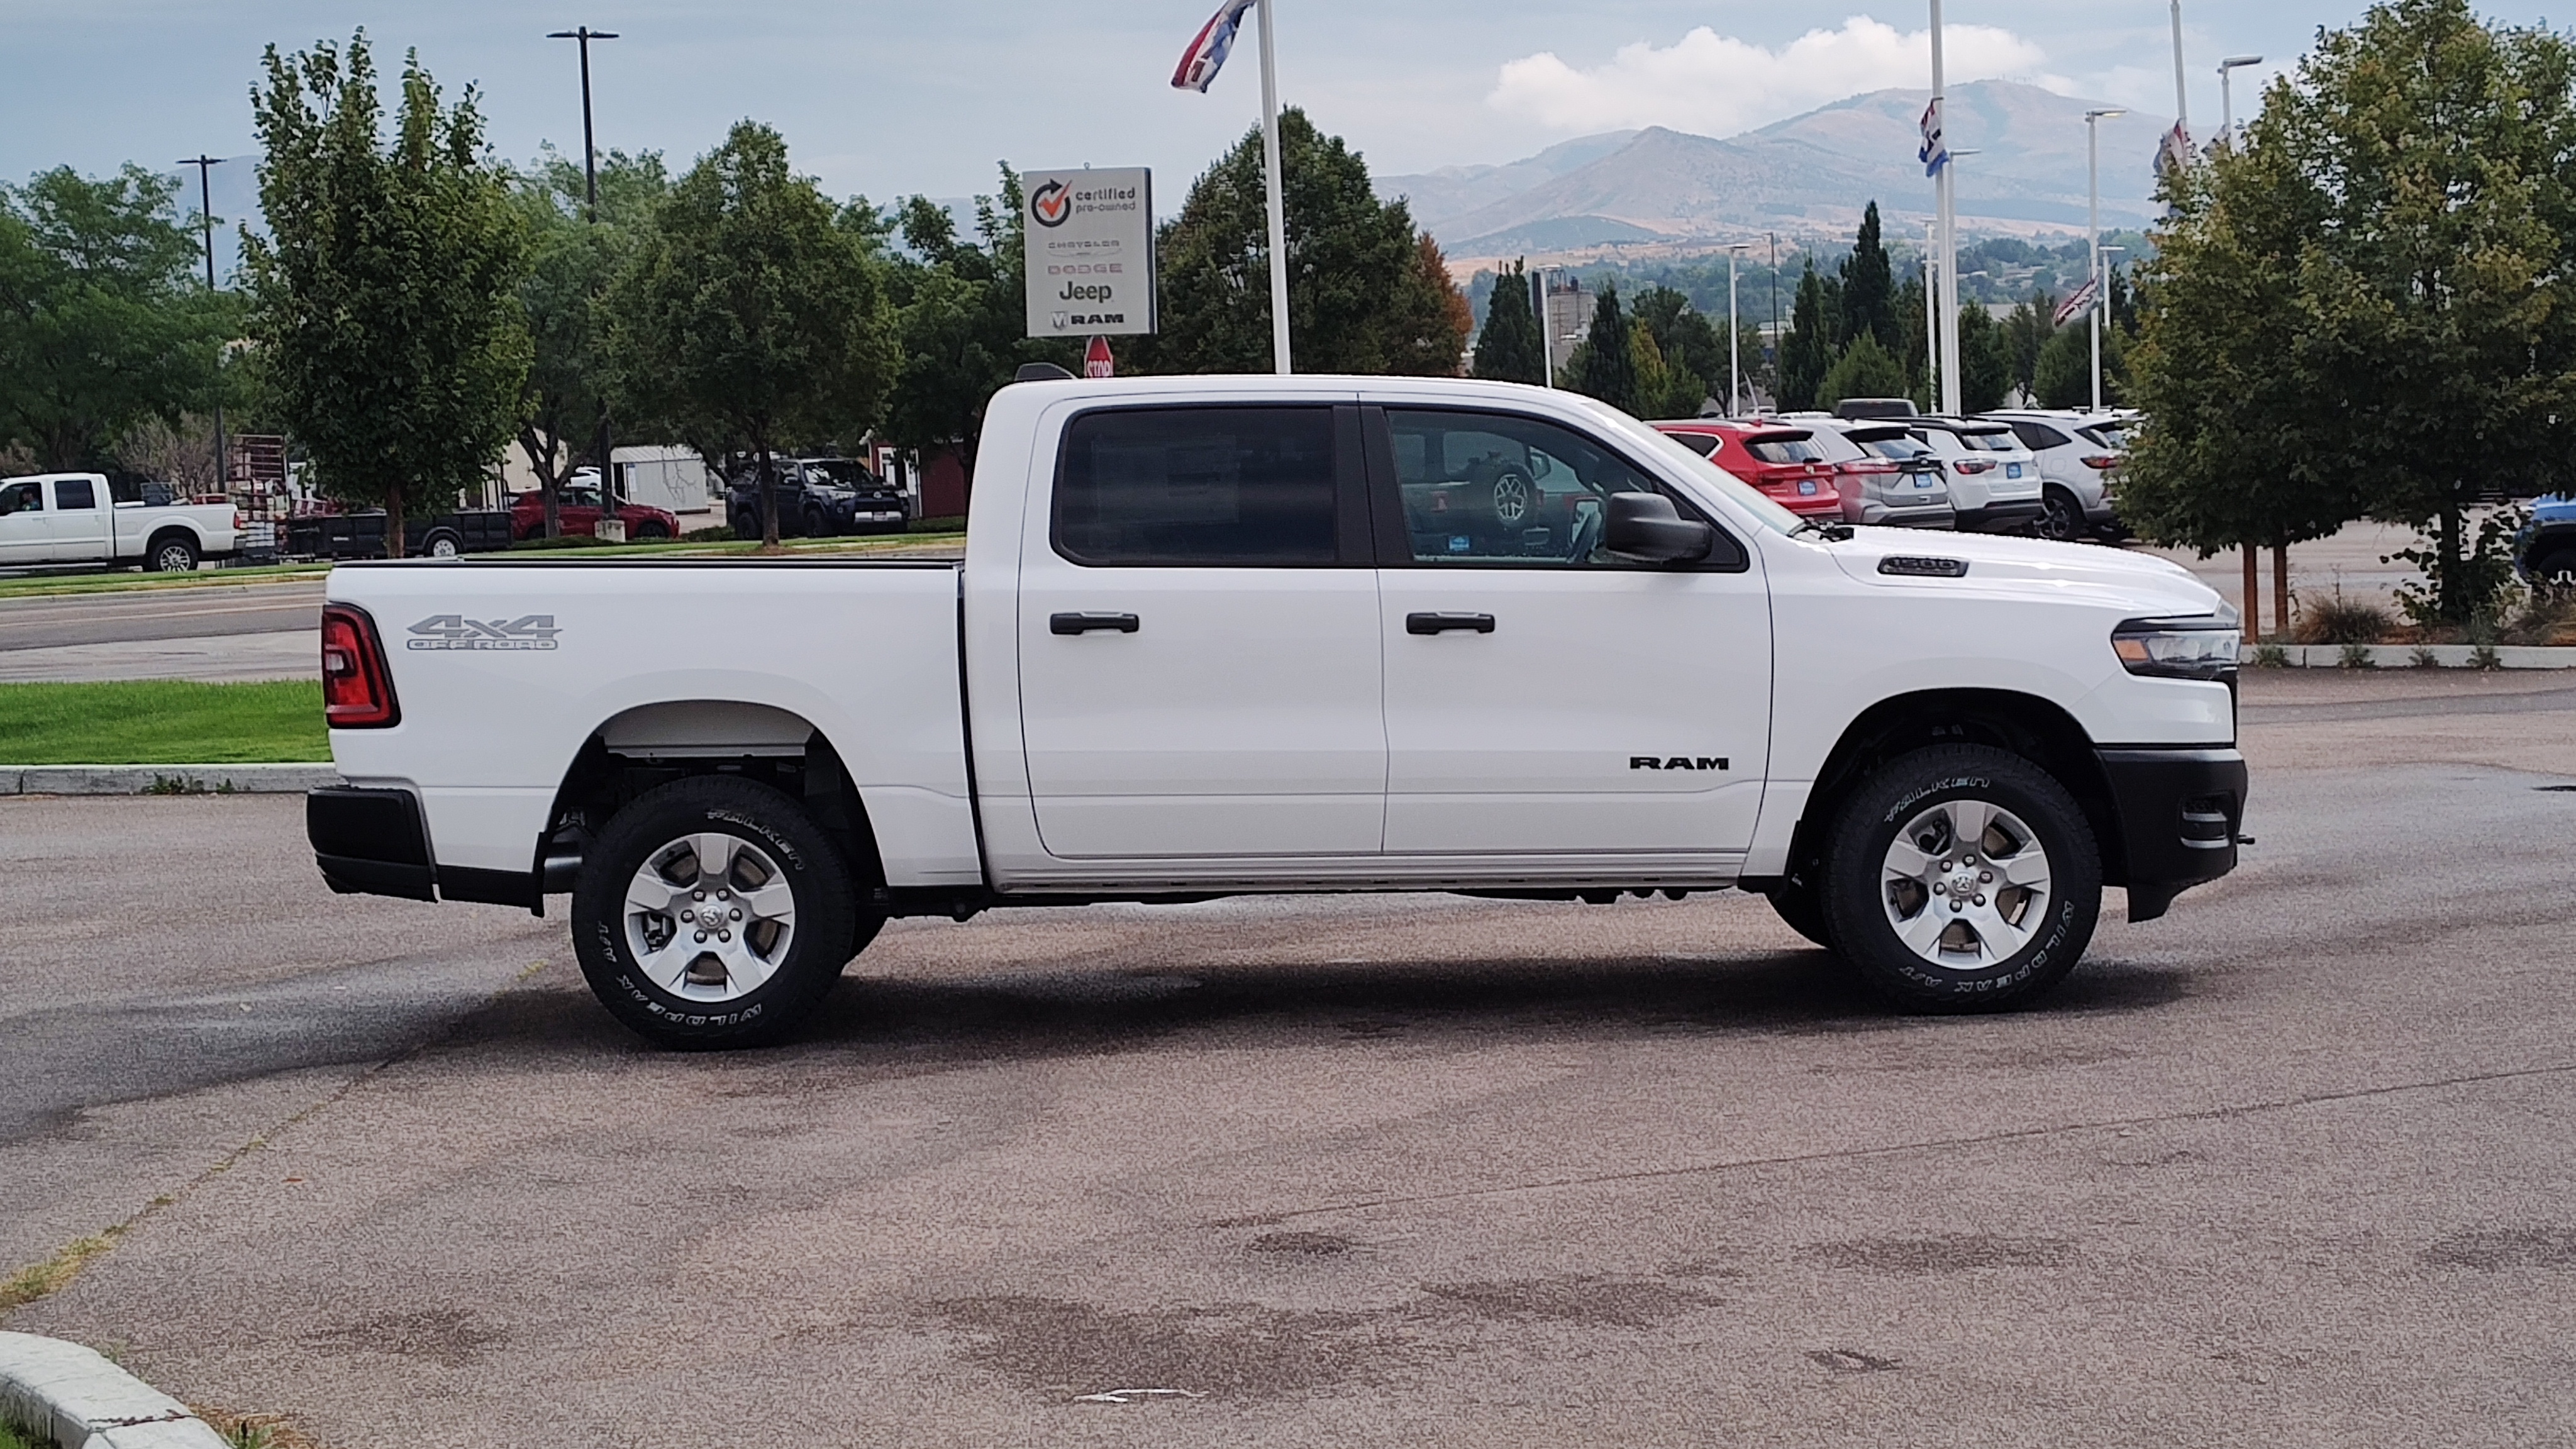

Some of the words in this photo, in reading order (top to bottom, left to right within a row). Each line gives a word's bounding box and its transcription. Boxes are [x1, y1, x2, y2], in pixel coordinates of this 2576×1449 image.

[1075, 187, 1136, 201] certified
[1075, 201, 1136, 214] pre-owned
[1048, 240, 1119, 248] CHRYSLER
[1048, 264, 1123, 275] DODGE
[1059, 281, 1112, 303] Jeep
[1071, 314, 1124, 325] RAM
[1087, 360, 1111, 377] STOP
[1630, 757, 1729, 770] RAM
